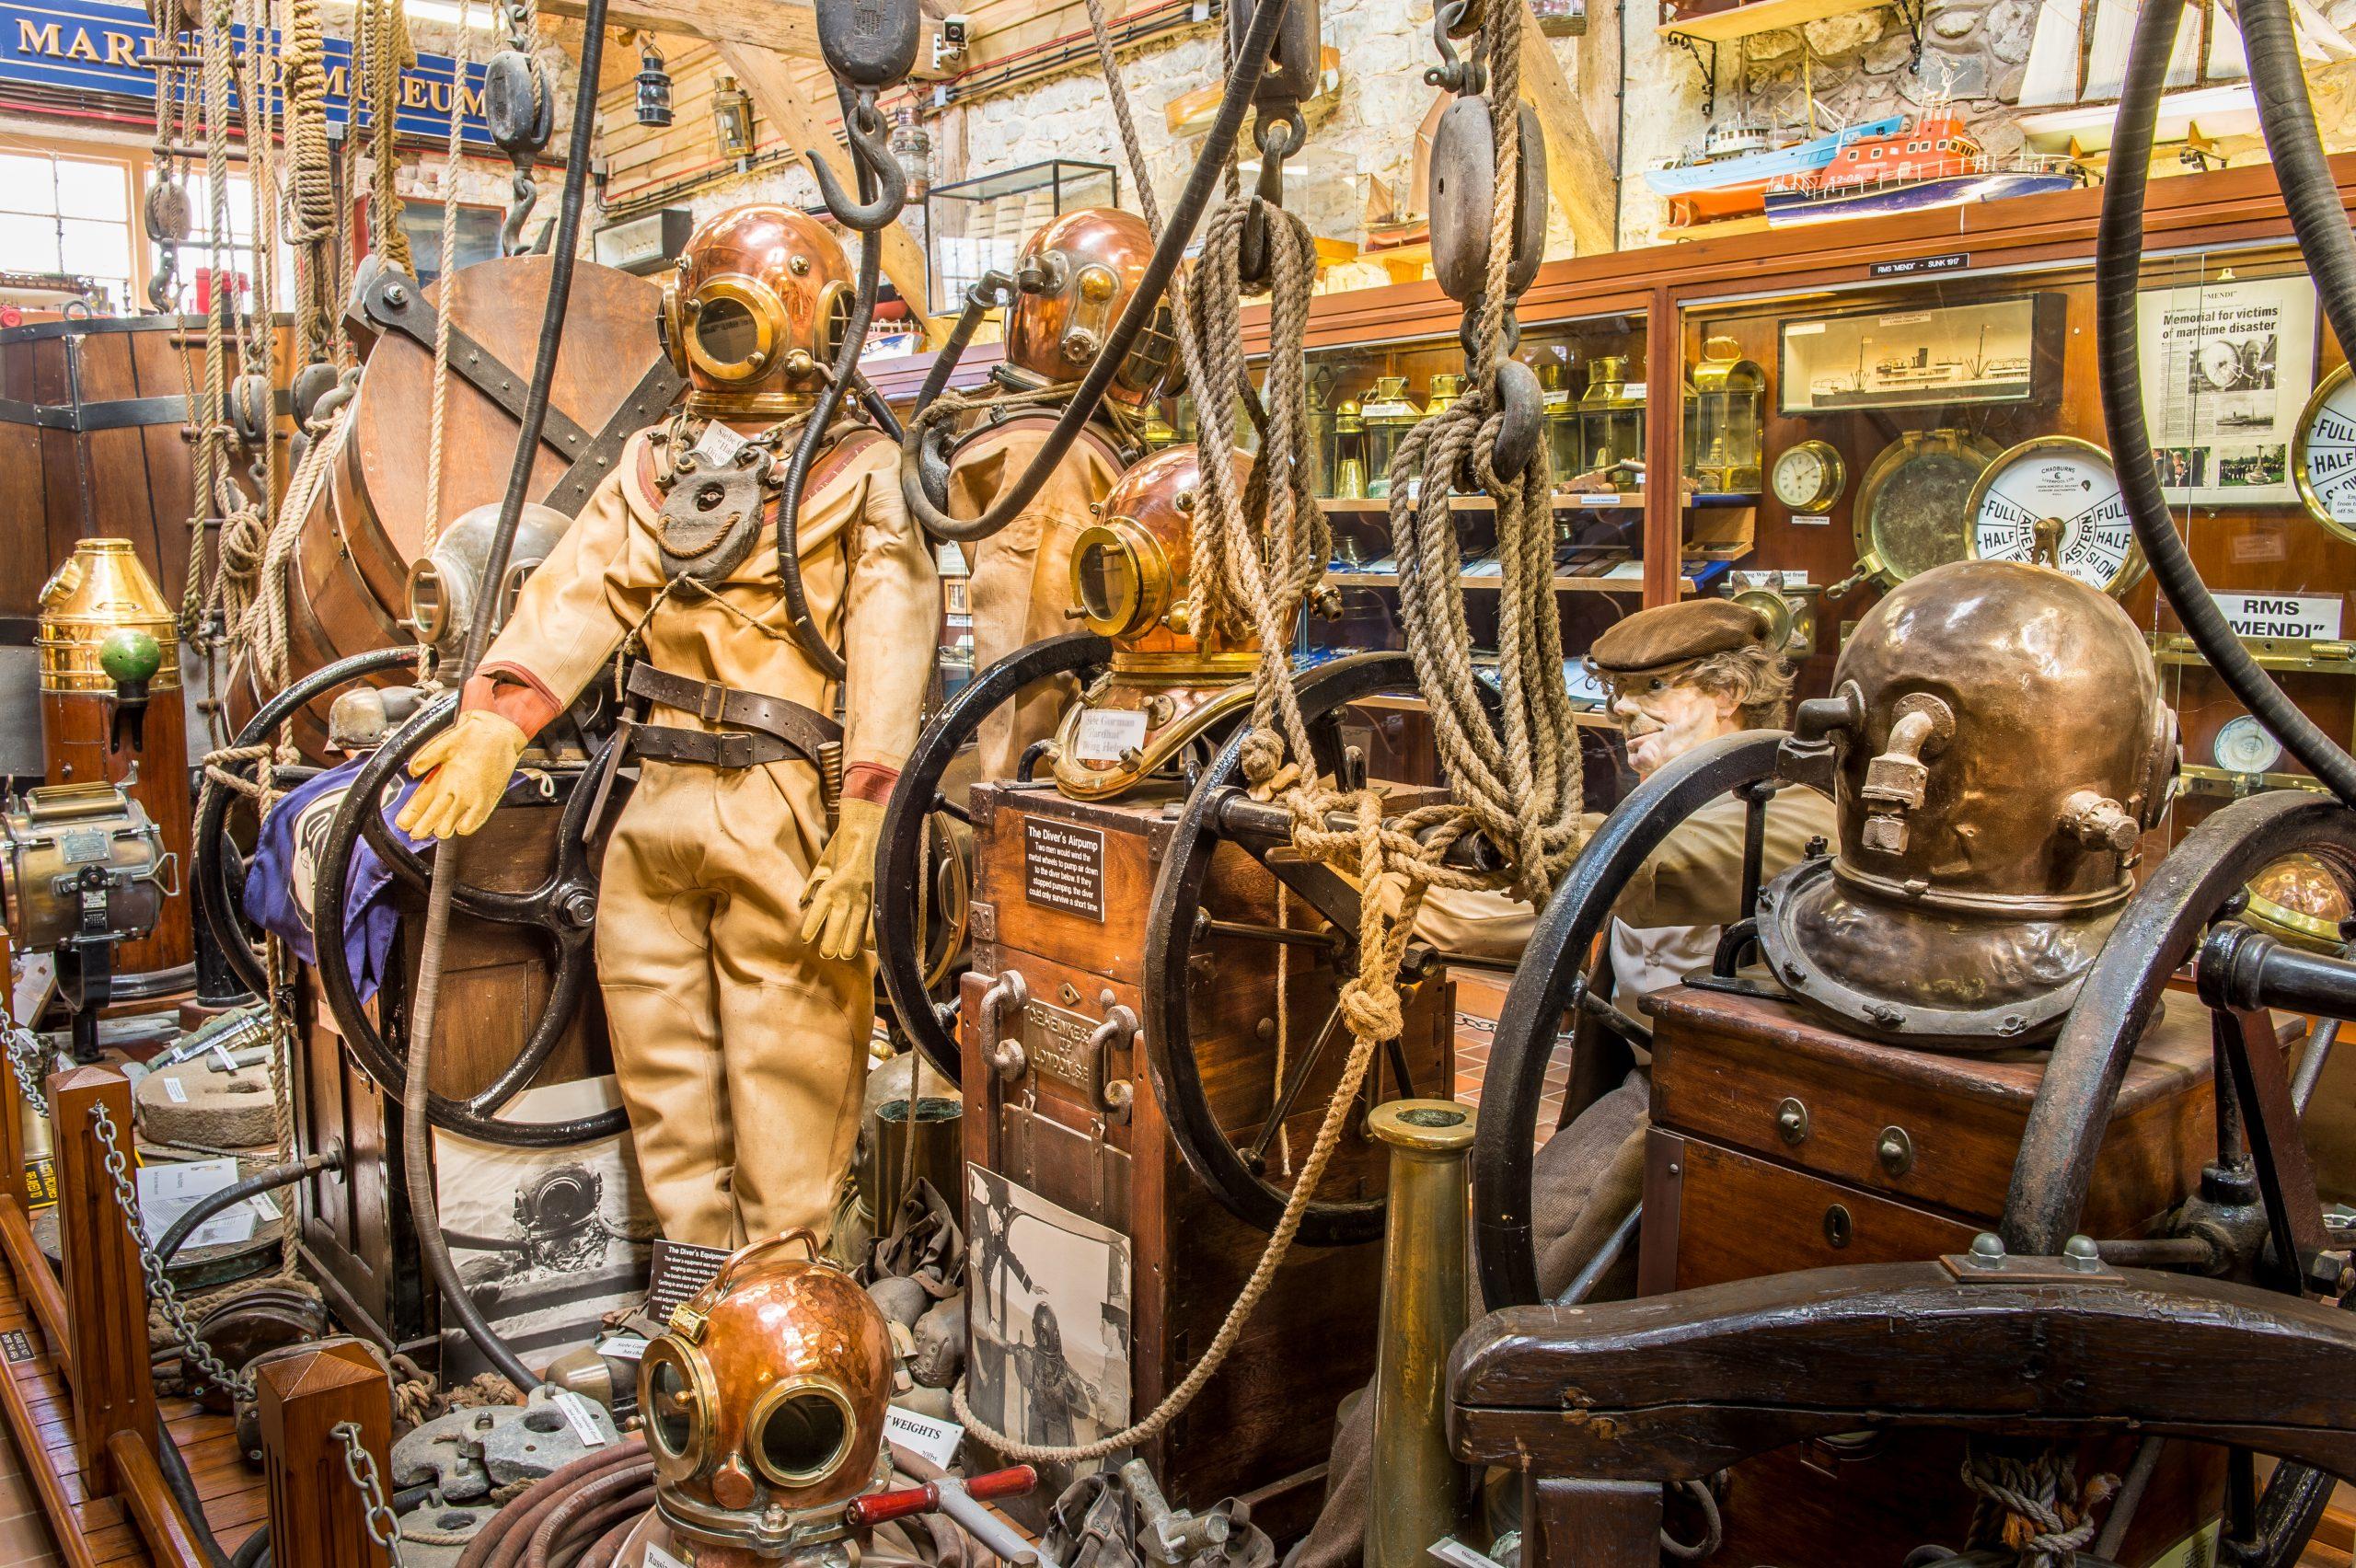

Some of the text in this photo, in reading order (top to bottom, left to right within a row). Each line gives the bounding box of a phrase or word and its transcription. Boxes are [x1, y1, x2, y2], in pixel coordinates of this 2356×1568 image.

[1928, 259, 1946, 268] SUNK
[1946, 258, 1959, 266] 1917
[2163, 311, 2215, 325] Memorial
[2218, 309, 2233, 320] for
[2236, 306, 2278, 319] victims
[2163, 320, 2277, 340] of maritime disaster
[2316, 418, 2355, 442] FULL
[2041, 466, 2076, 474] CHADBURNS
[2315, 453, 2353, 475] HALF
[1985, 500, 2016, 522] FULL
[1983, 531, 2015, 549] HALF
[2065, 514, 2093, 564] ASTERN
[2096, 531, 2131, 550] HALF
[2085, 552, 2119, 582] SLOW
[2243, 599, 2300, 616] RMS
[1028, 825, 1041, 838] The
[1068, 835, 1098, 852] Airpump
[1035, 841, 1045, 852] Two
[1045, 846, 1057, 854] men
[1057, 847, 1070, 858] would
[1071, 850, 1082, 860] wind
[1029, 853, 1041, 862] metal
[1042, 855, 1057, 866] wheels
[1058, 859, 1064, 868] to
[1064, 861, 1077, 872] pump
[1084, 866, 1099, 876] down
[1034, 866, 1040, 874] to
[1040, 866, 1048, 876] the
[1048, 869, 1060, 879] diver
[1080, 875, 1092, 888] they
[1029, 888, 1042, 897] could
[1042, 890, 1052, 902] only
[1052, 893, 1068, 905] survive
[1069, 898, 1073, 906] a
[1074, 899, 1087, 909] short
[1033, 877, 1052, 889] stopped
[1073, 886, 1081, 895] the
[1081, 889, 1094, 899] diver
[668, 1246, 679, 1254] The
[658, 1279, 672, 1287] Getting
[892, 1416, 941, 1440] WEIGHTS
